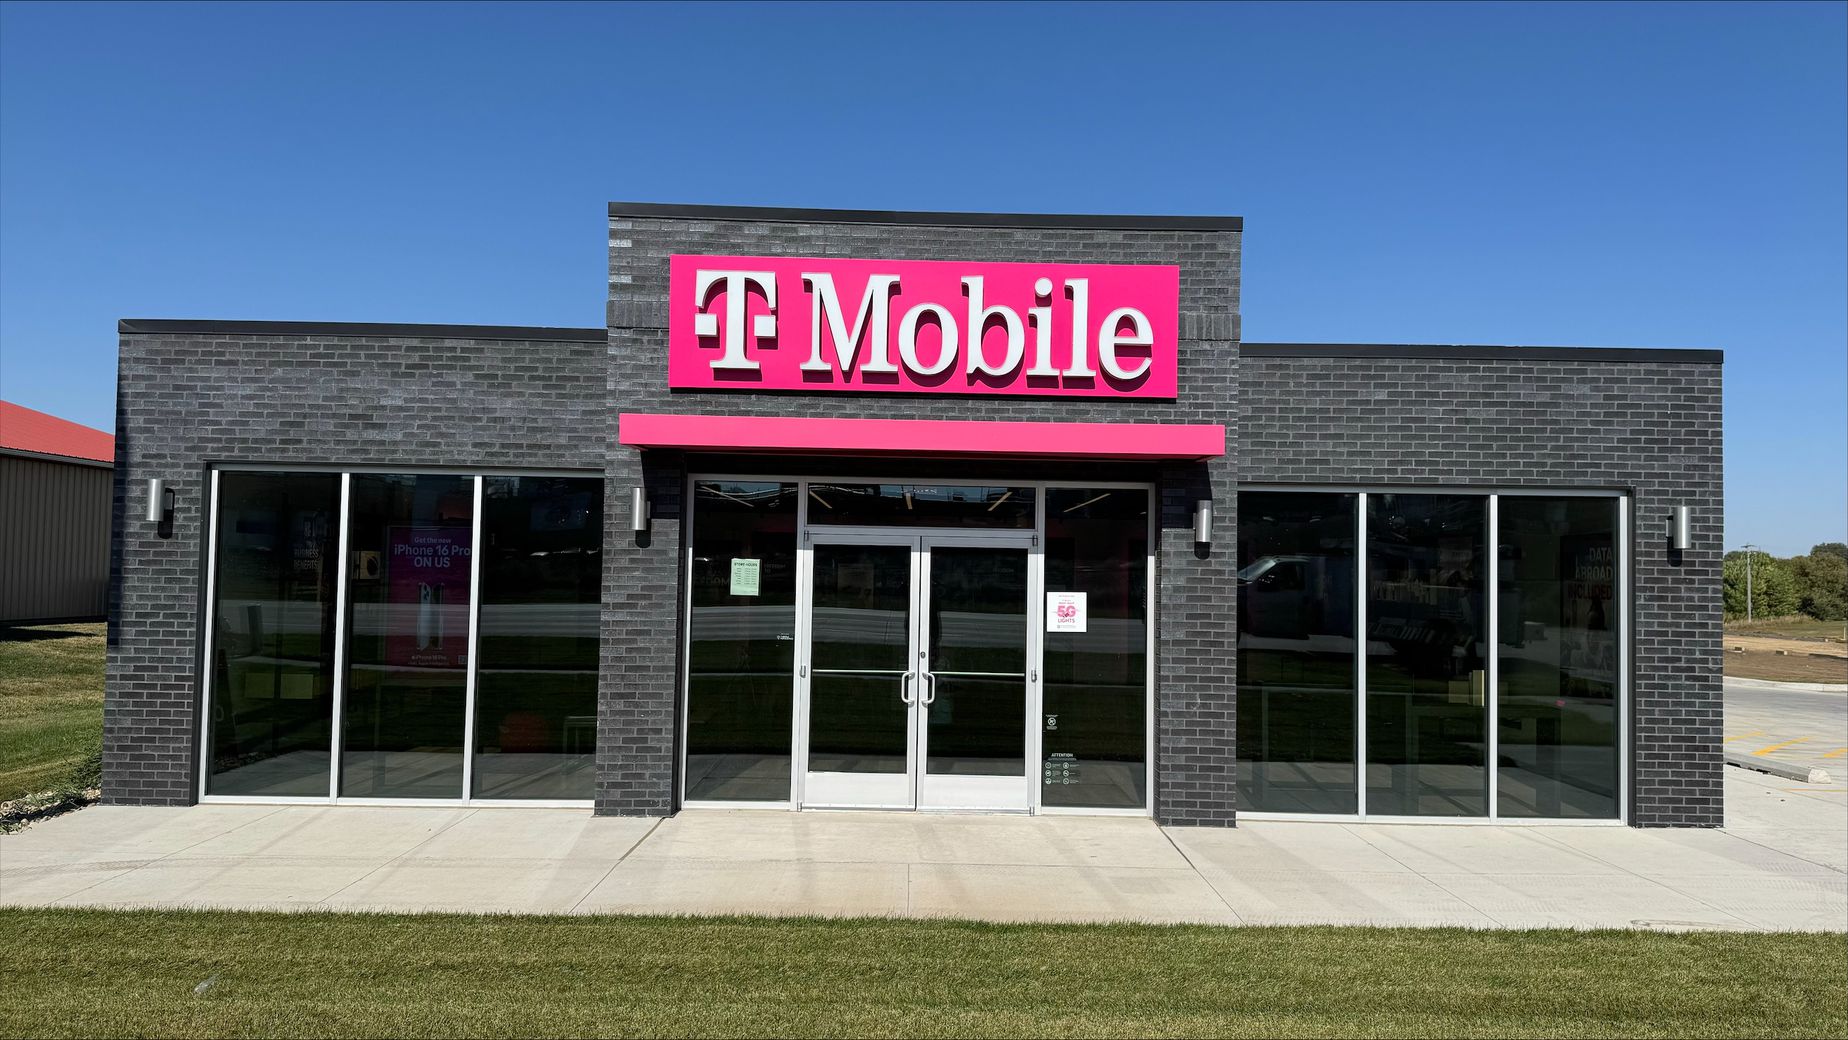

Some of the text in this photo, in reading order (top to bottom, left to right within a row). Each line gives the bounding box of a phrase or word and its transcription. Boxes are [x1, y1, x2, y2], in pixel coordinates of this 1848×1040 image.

[694, 269, 1154, 380] T Mobile
[394, 543, 471, 556] iPhone 16 Pro
[1589, 546, 1613, 562] DATA
[414, 556, 451, 568] ON US
[1575, 566, 1613, 580] ABROAD
[1568, 584, 1613, 600] INCLUDED
[1057, 605, 1076, 618] 5G
